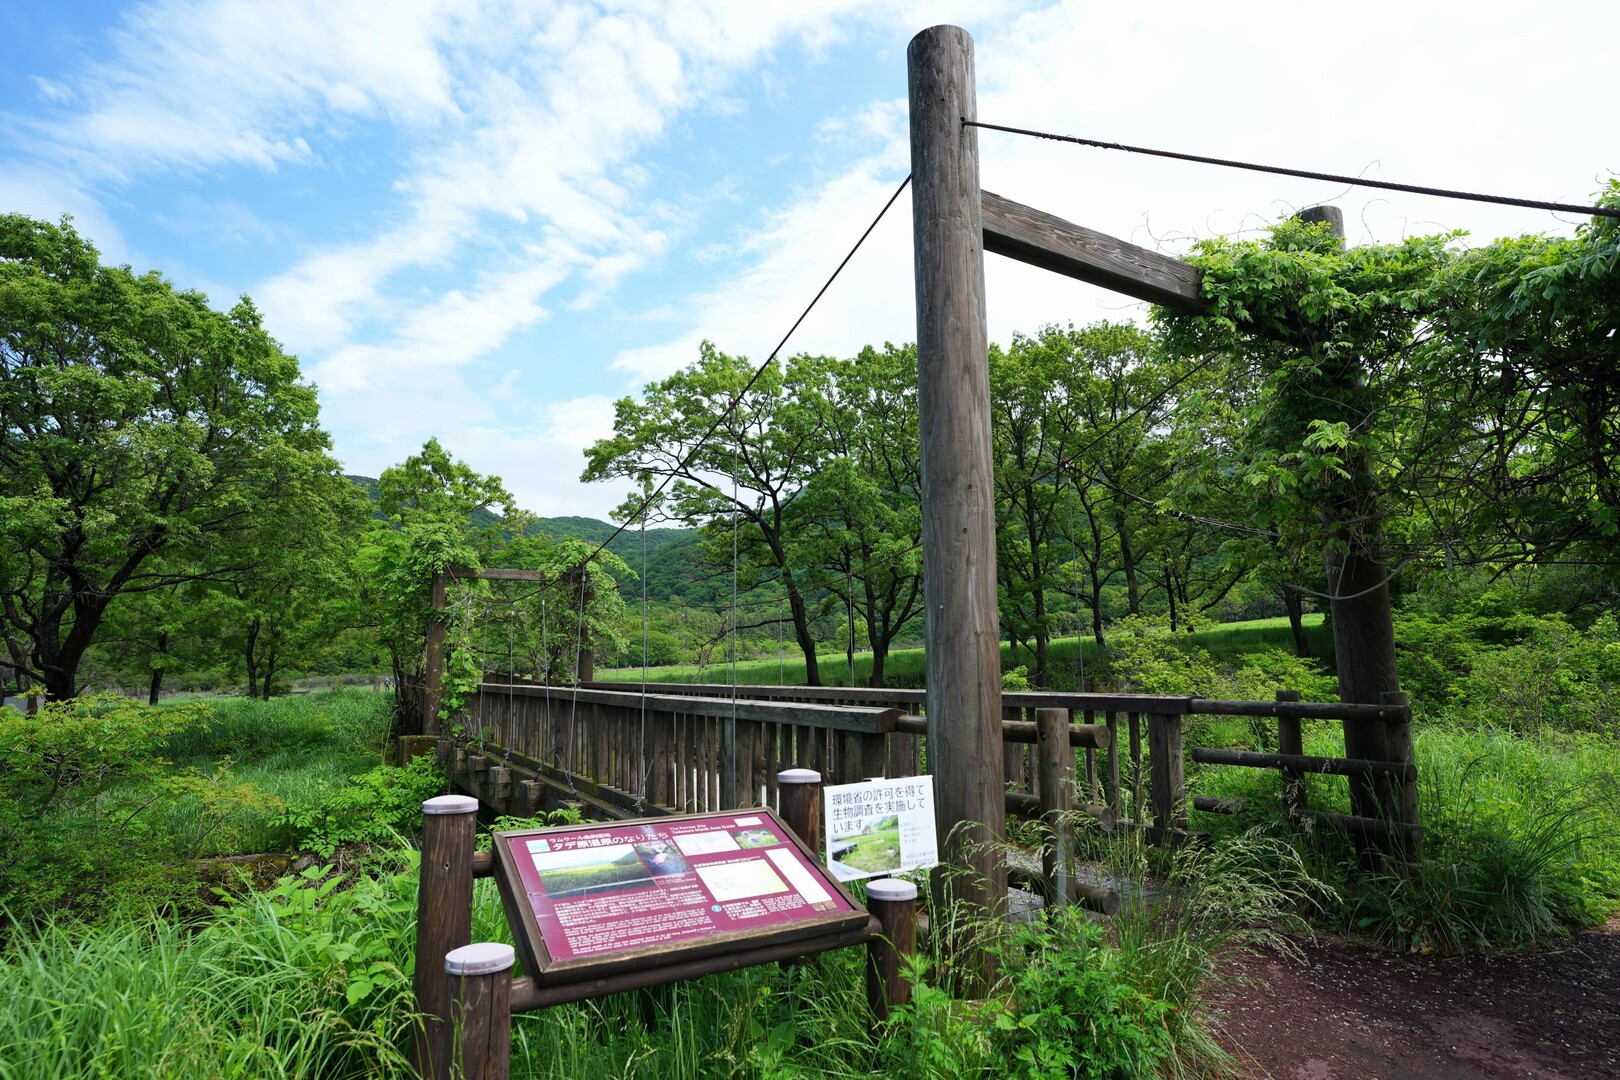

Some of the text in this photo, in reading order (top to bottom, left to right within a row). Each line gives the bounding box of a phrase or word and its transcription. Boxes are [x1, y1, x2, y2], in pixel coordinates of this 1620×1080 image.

[832, 784, 925, 806] 環境省の許可を得て
[832, 797, 926, 821] 生物調査を実施して
[553, 832, 669, 851] タデ原湿原のなりたち
